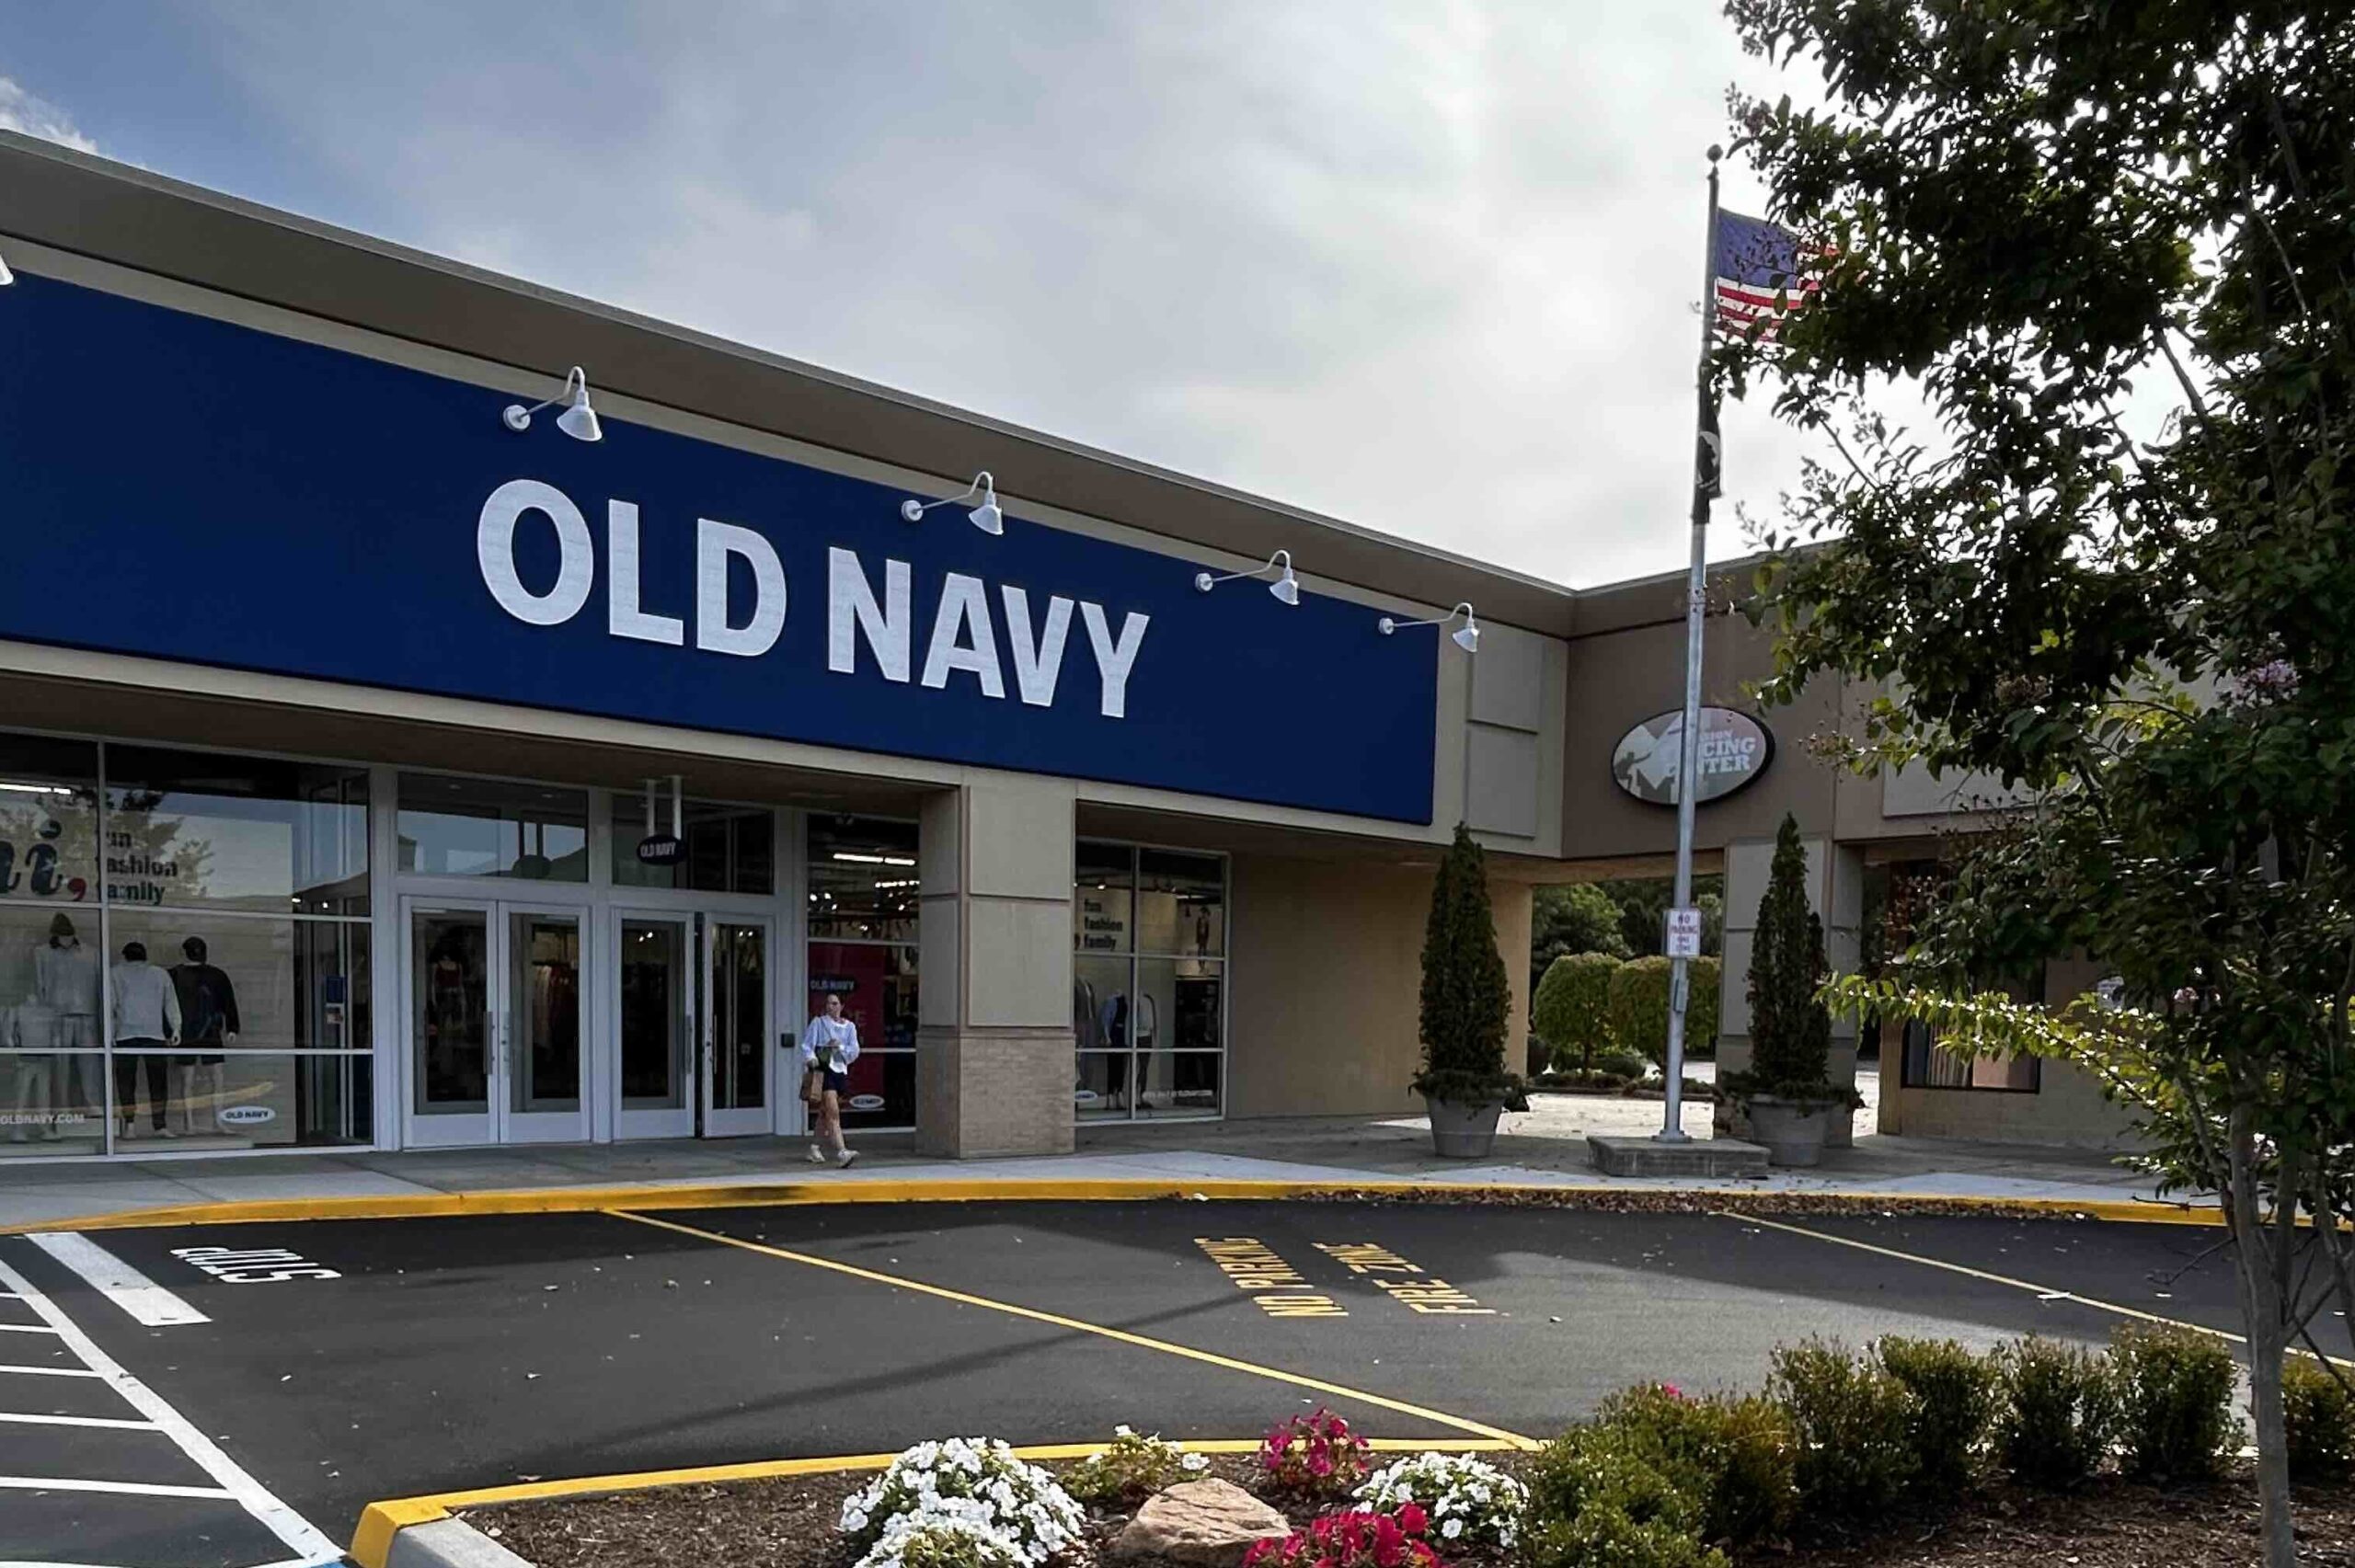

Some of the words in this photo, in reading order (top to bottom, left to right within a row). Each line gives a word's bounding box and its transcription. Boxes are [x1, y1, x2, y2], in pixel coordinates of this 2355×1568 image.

[477, 478, 787, 658] OLD
[828, 545, 1150, 719] NAVY
[1699, 737, 1757, 757] CING
[105, 854, 178, 877] ashion
[106, 880, 167, 905] amily
[1084, 916, 1123, 933] fashion
[1678, 913, 1691, 924] NO
[1084, 933, 1117, 952] family
[225, 1111, 244, 1120] OLD
[245, 1110, 269, 1119] NAVY
[169, 1246, 343, 1284] STOP
[1193, 1237, 1315, 1289] PARKING
[1310, 1242, 1426, 1274] ZONE
[1252, 1294, 1350, 1317] NO
[1373, 1278, 1497, 1315] FIRE
